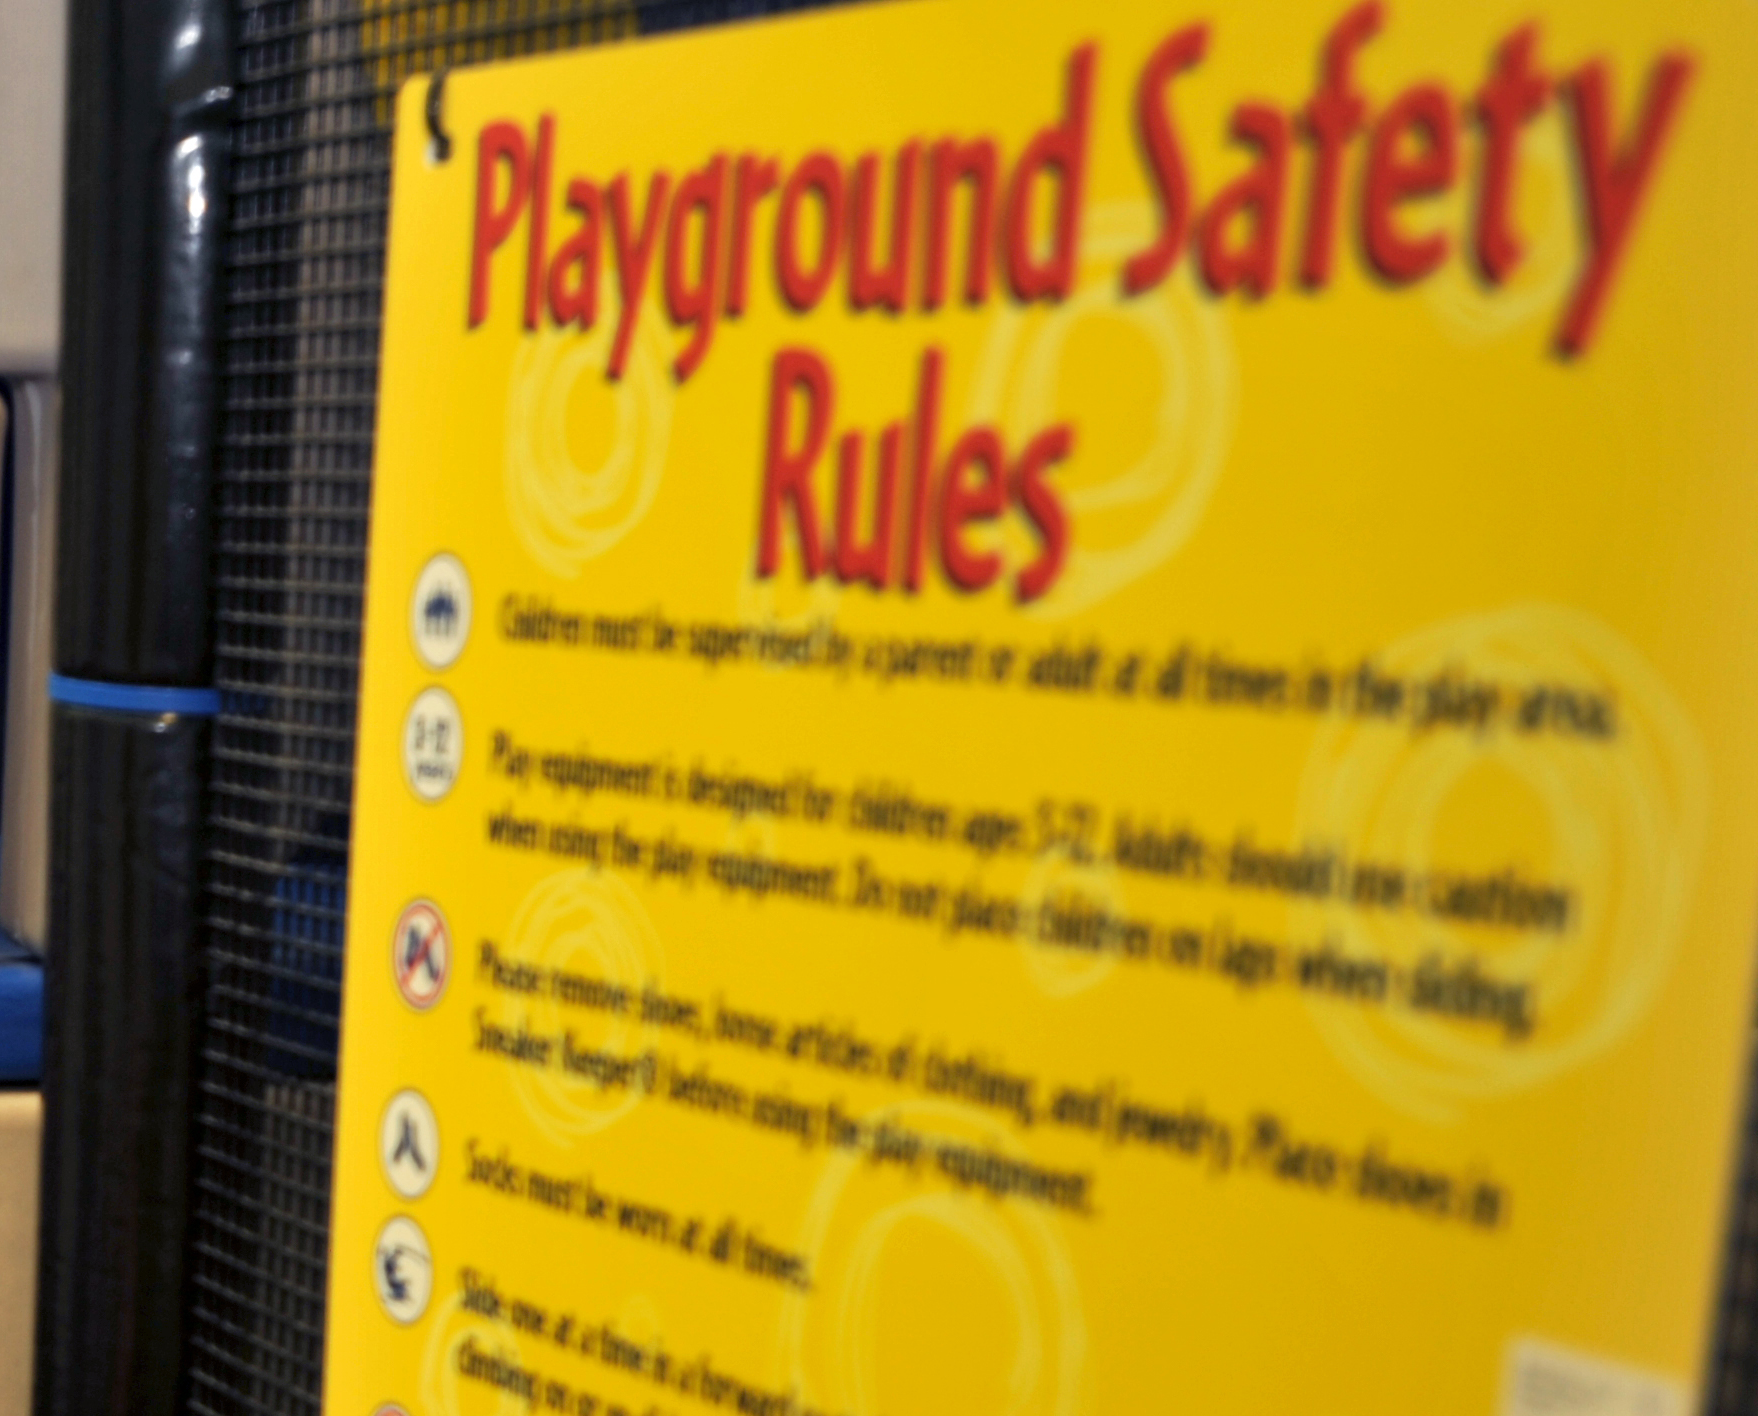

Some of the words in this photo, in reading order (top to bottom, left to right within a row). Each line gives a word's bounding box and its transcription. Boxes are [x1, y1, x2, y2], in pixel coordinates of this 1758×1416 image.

[464, 40, 1102, 382] Playground
[1122, 0, 1694, 360] Safety
[754, 344, 1076, 606] Rules
